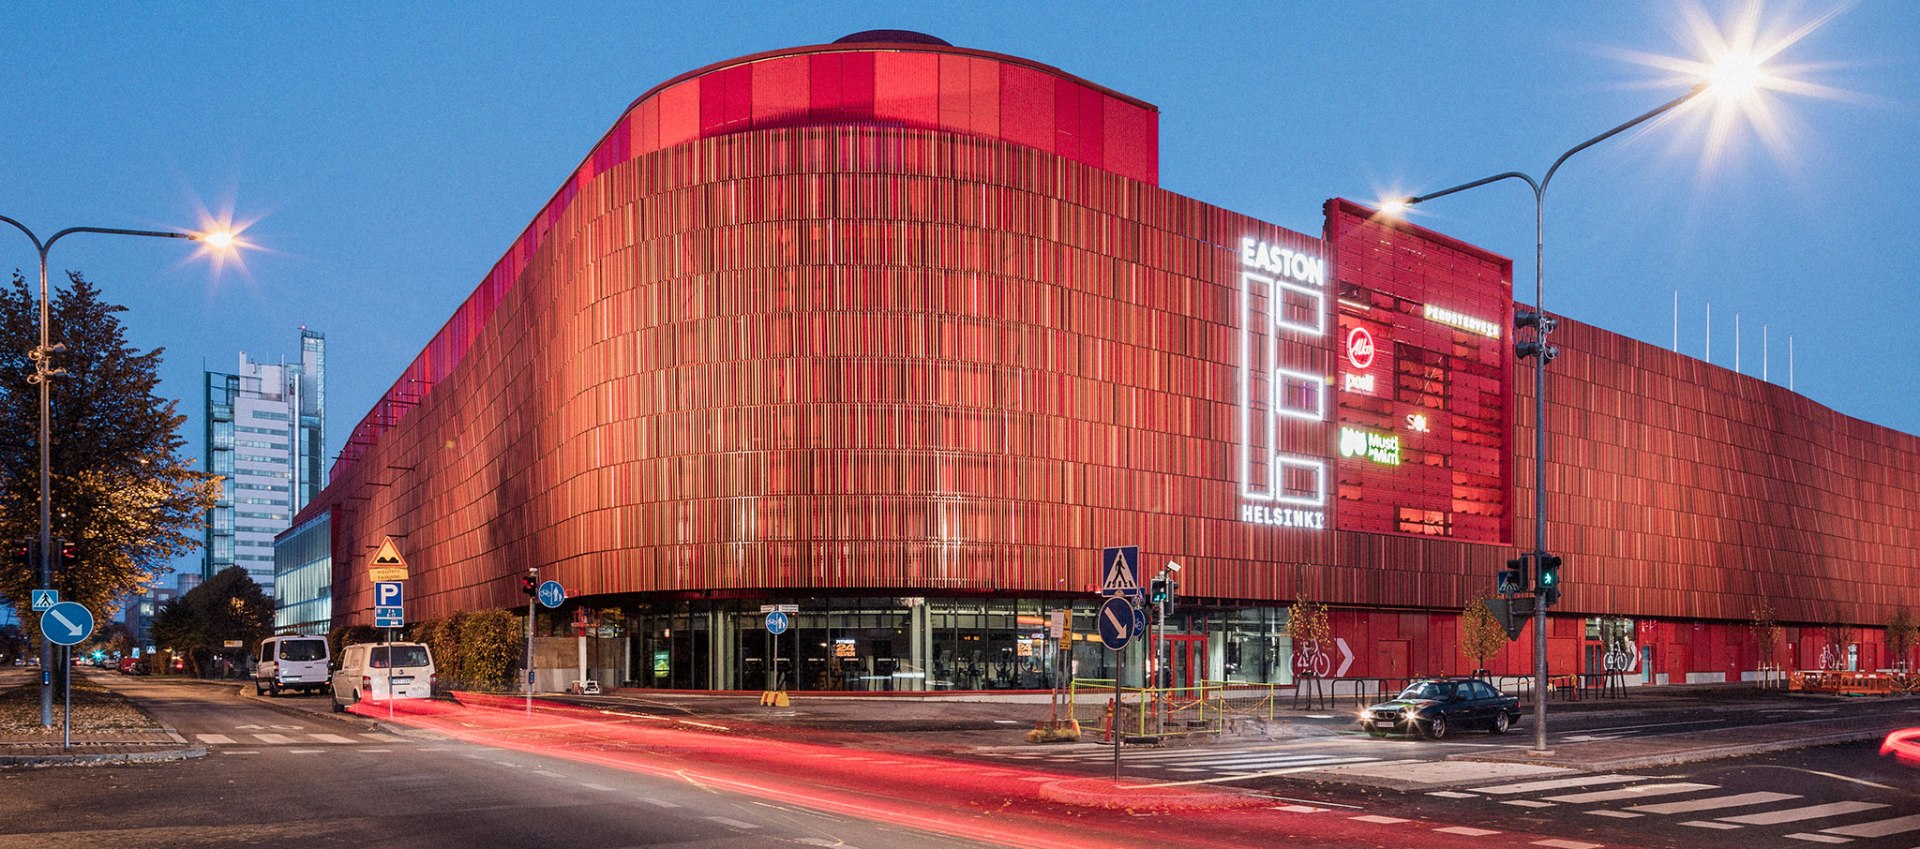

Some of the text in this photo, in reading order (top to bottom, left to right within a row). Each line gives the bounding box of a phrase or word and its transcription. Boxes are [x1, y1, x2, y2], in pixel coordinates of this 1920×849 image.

[1242, 237, 1324, 286] EASTON
[1351, 337, 1372, 356] Alko
[1406, 414, 1430, 433] SOL
[1368, 433, 1399, 450] Musti
[1242, 504, 1325, 530] HELSINKI
[380, 584, 399, 605] P
